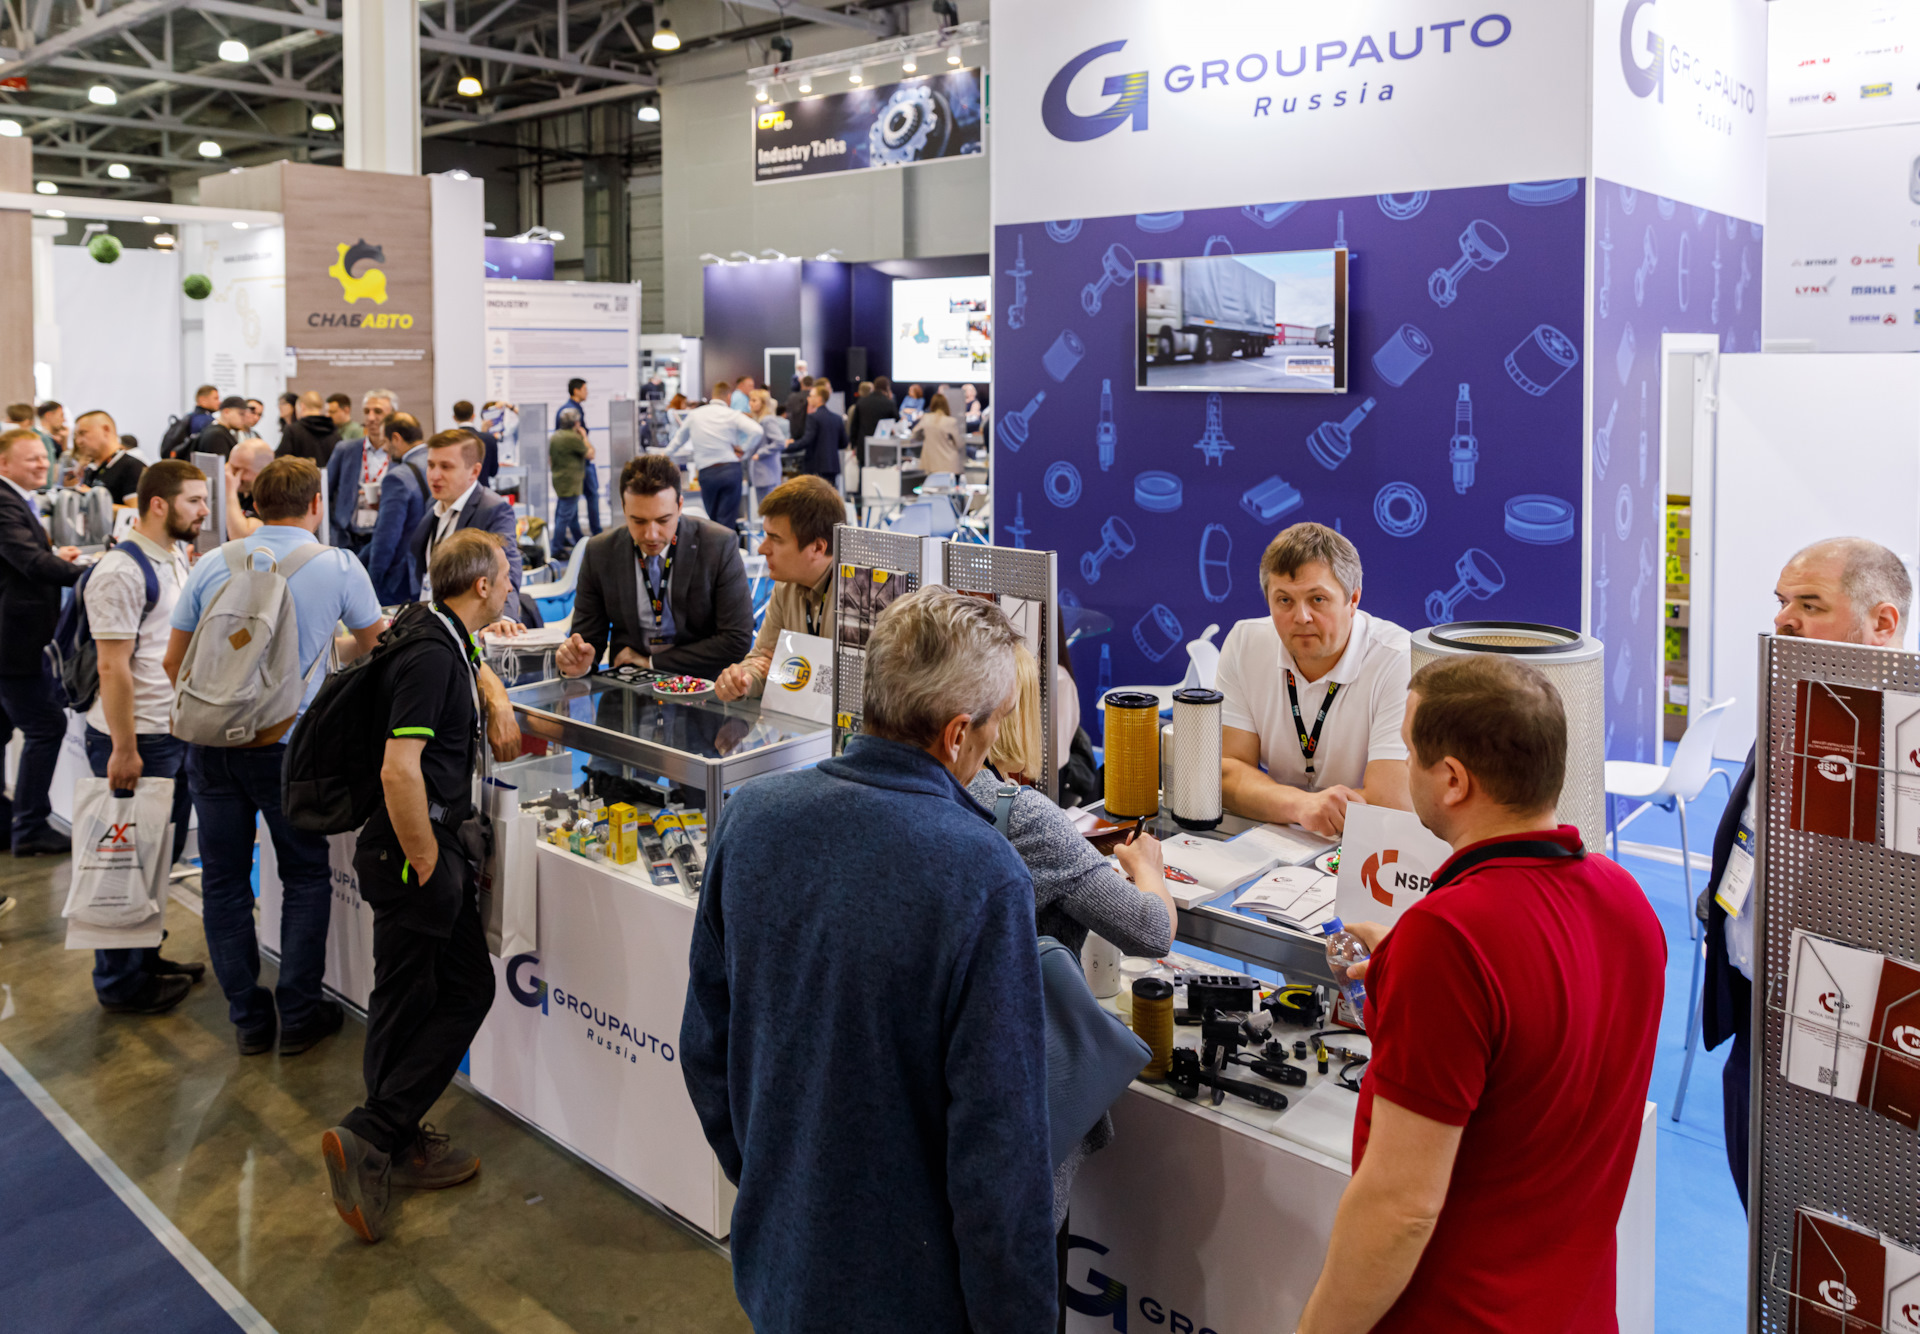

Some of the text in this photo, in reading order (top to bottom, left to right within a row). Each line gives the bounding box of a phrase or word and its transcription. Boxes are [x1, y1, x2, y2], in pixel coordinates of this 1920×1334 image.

[1164, 14, 1512, 93] GROUPAUTO
[1253, 82, 1394, 118] Russia
[758, 138, 847, 165] Industry Talks
[307, 312, 414, 329] СНАБАВТО
[1817, 762, 1839, 773] NSP
[1394, 870, 1432, 893] NSP
[553, 987, 675, 1062] GROUPAUTO
[1825, 1014, 1839, 1022] SPAR
[586, 1028, 637, 1064] Russia
